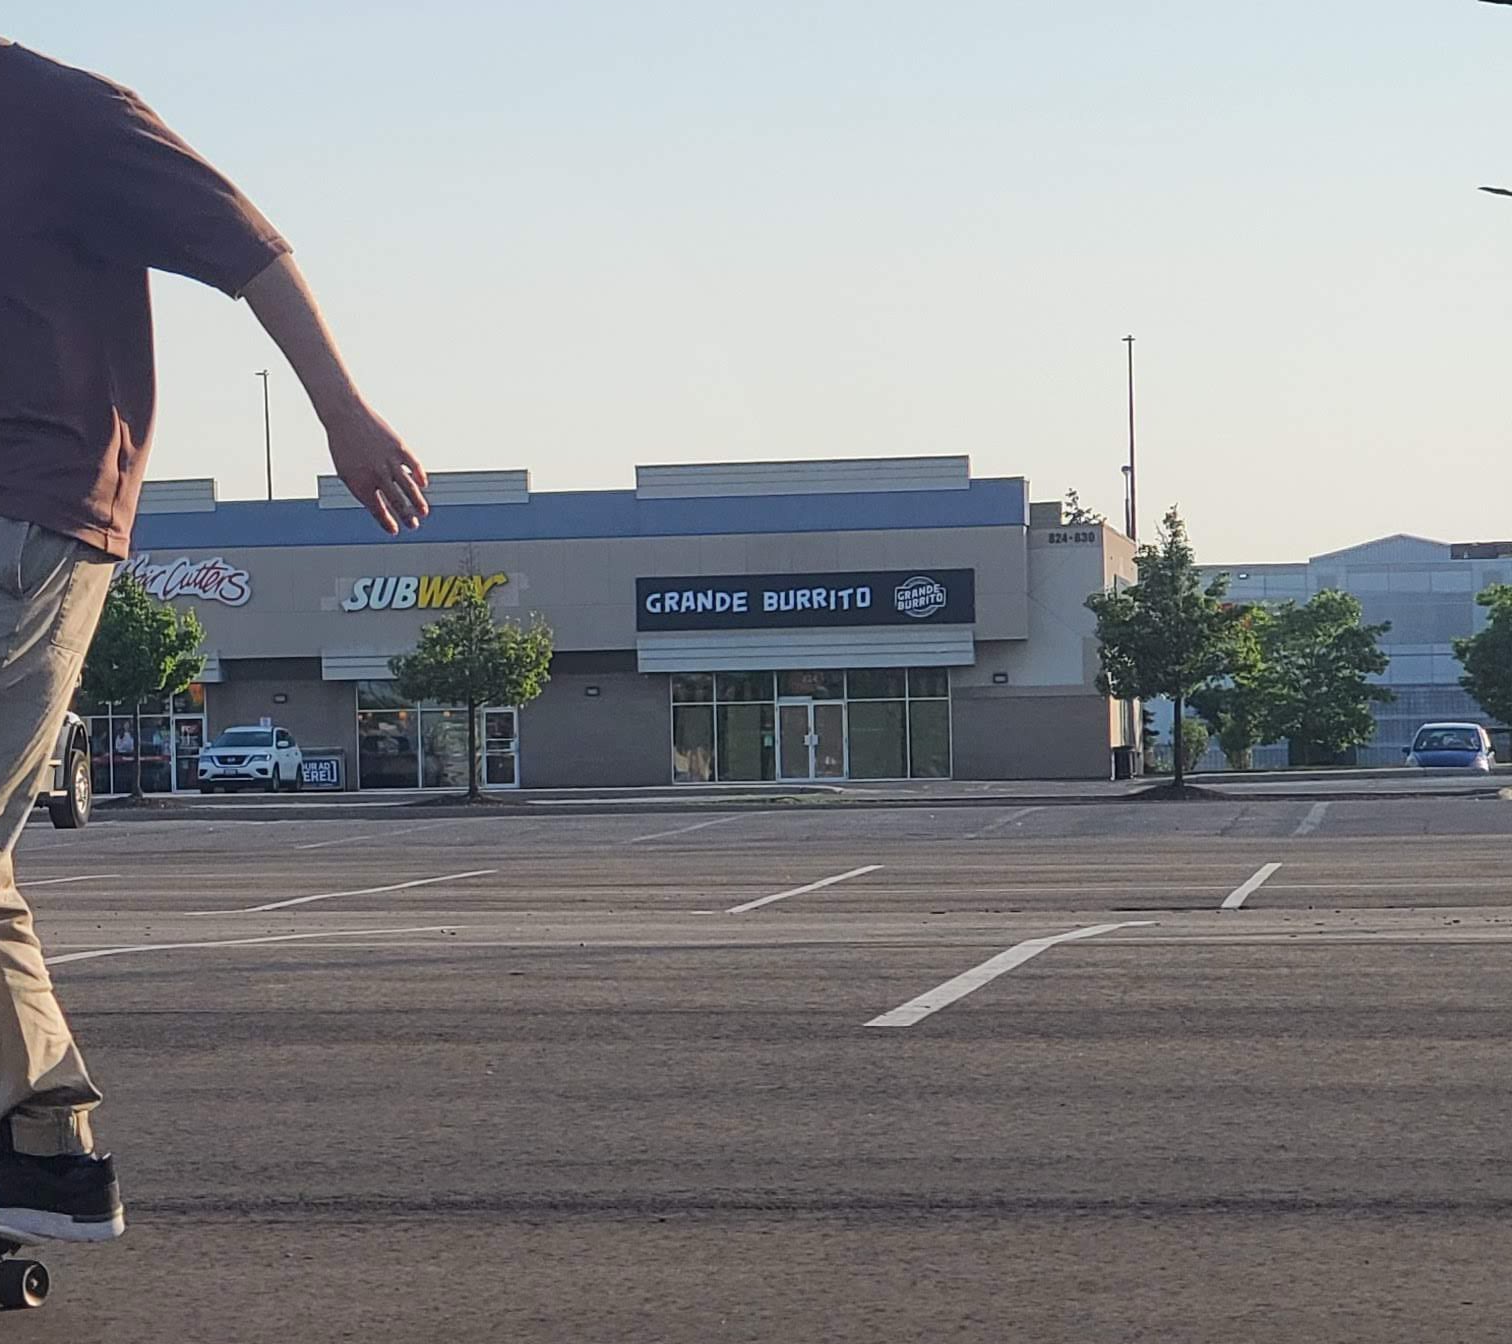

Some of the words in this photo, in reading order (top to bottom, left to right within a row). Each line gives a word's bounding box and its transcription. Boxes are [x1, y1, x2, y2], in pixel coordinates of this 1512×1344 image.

[342, 572, 508, 612] SUBWAY
[646, 589, 748, 613] GRANDE
[763, 587, 871, 611] BURRITO
[897, 583, 941, 601] GRANDE
[897, 592, 943, 611] BURRITO
